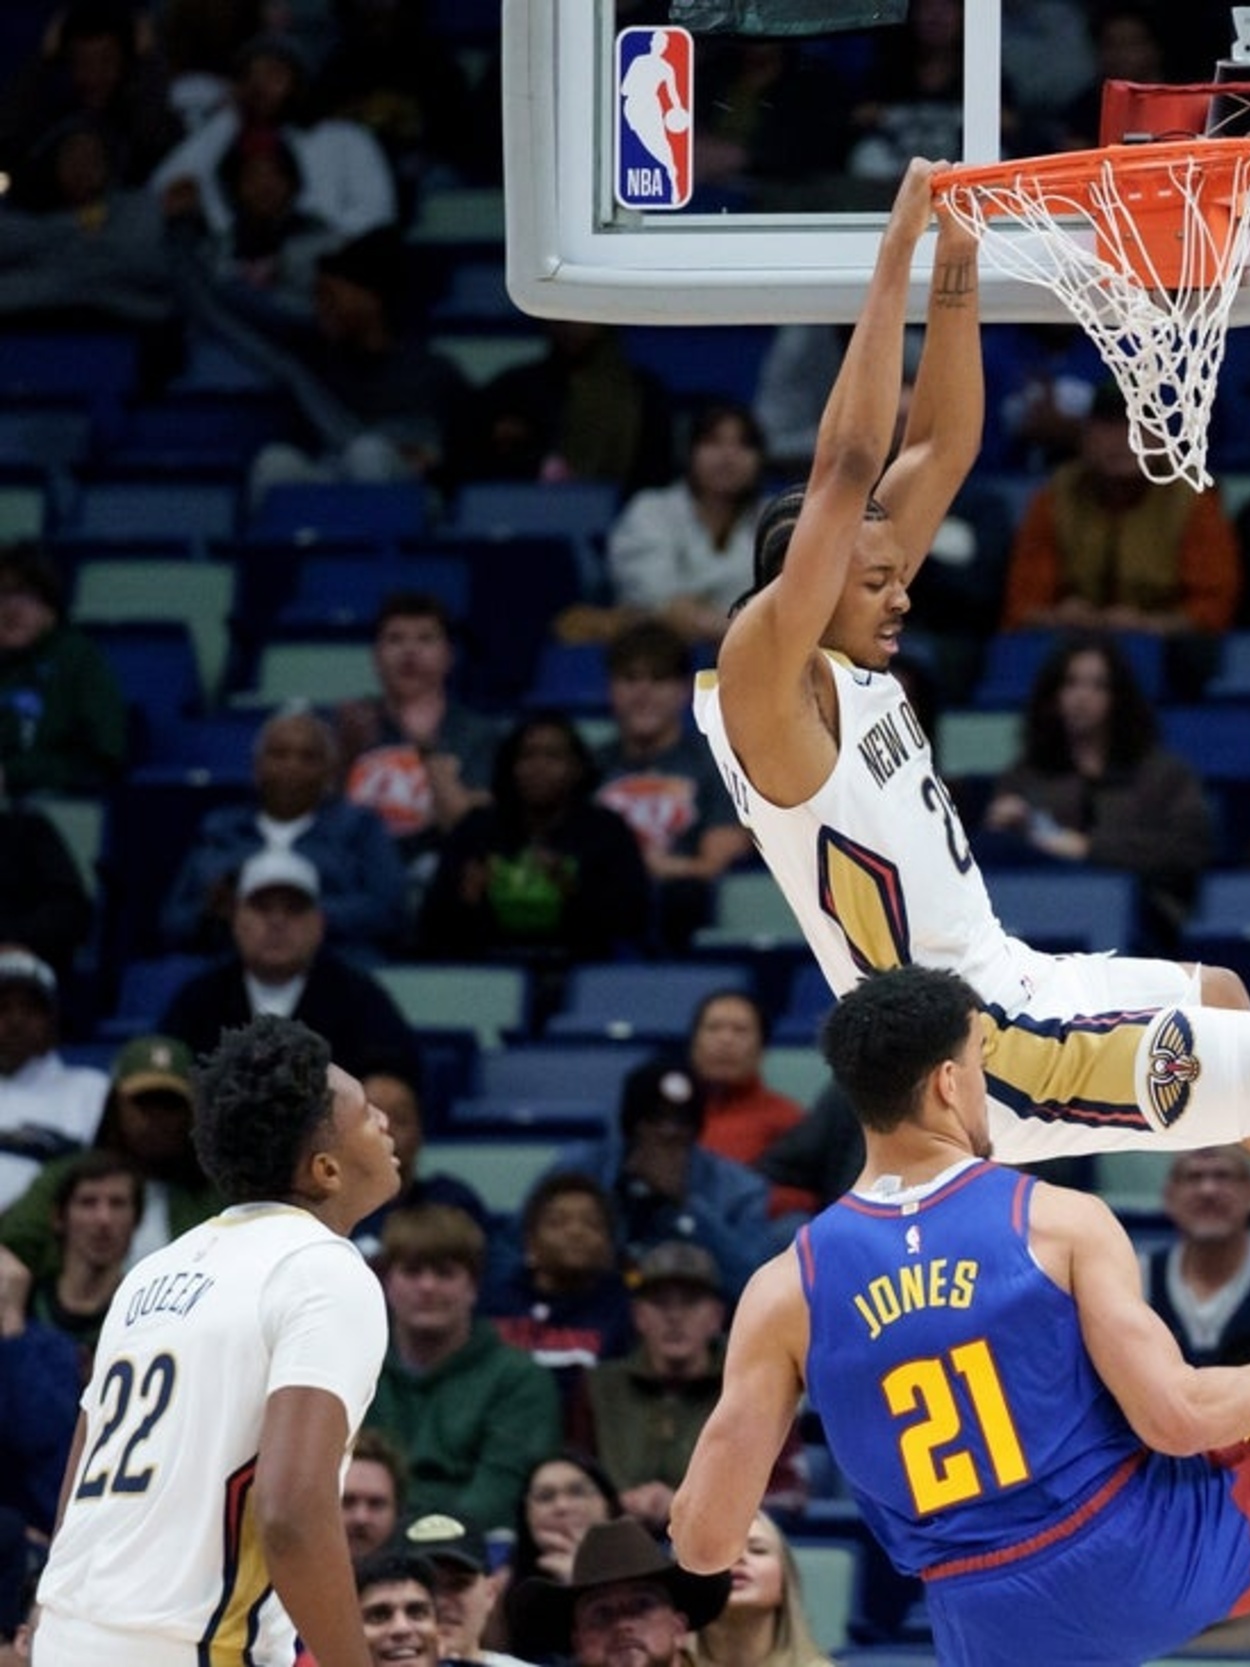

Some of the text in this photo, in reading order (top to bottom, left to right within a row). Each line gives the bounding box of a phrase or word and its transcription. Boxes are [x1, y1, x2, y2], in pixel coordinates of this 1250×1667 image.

[627, 167, 663, 197] NBA
[857, 712, 910, 790] NEW
[125, 1272, 214, 1327] QUEEN
[853, 1258, 979, 1340] JONES
[75, 1351, 177, 1501] 22
[879, 1335, 1031, 1519] 21
